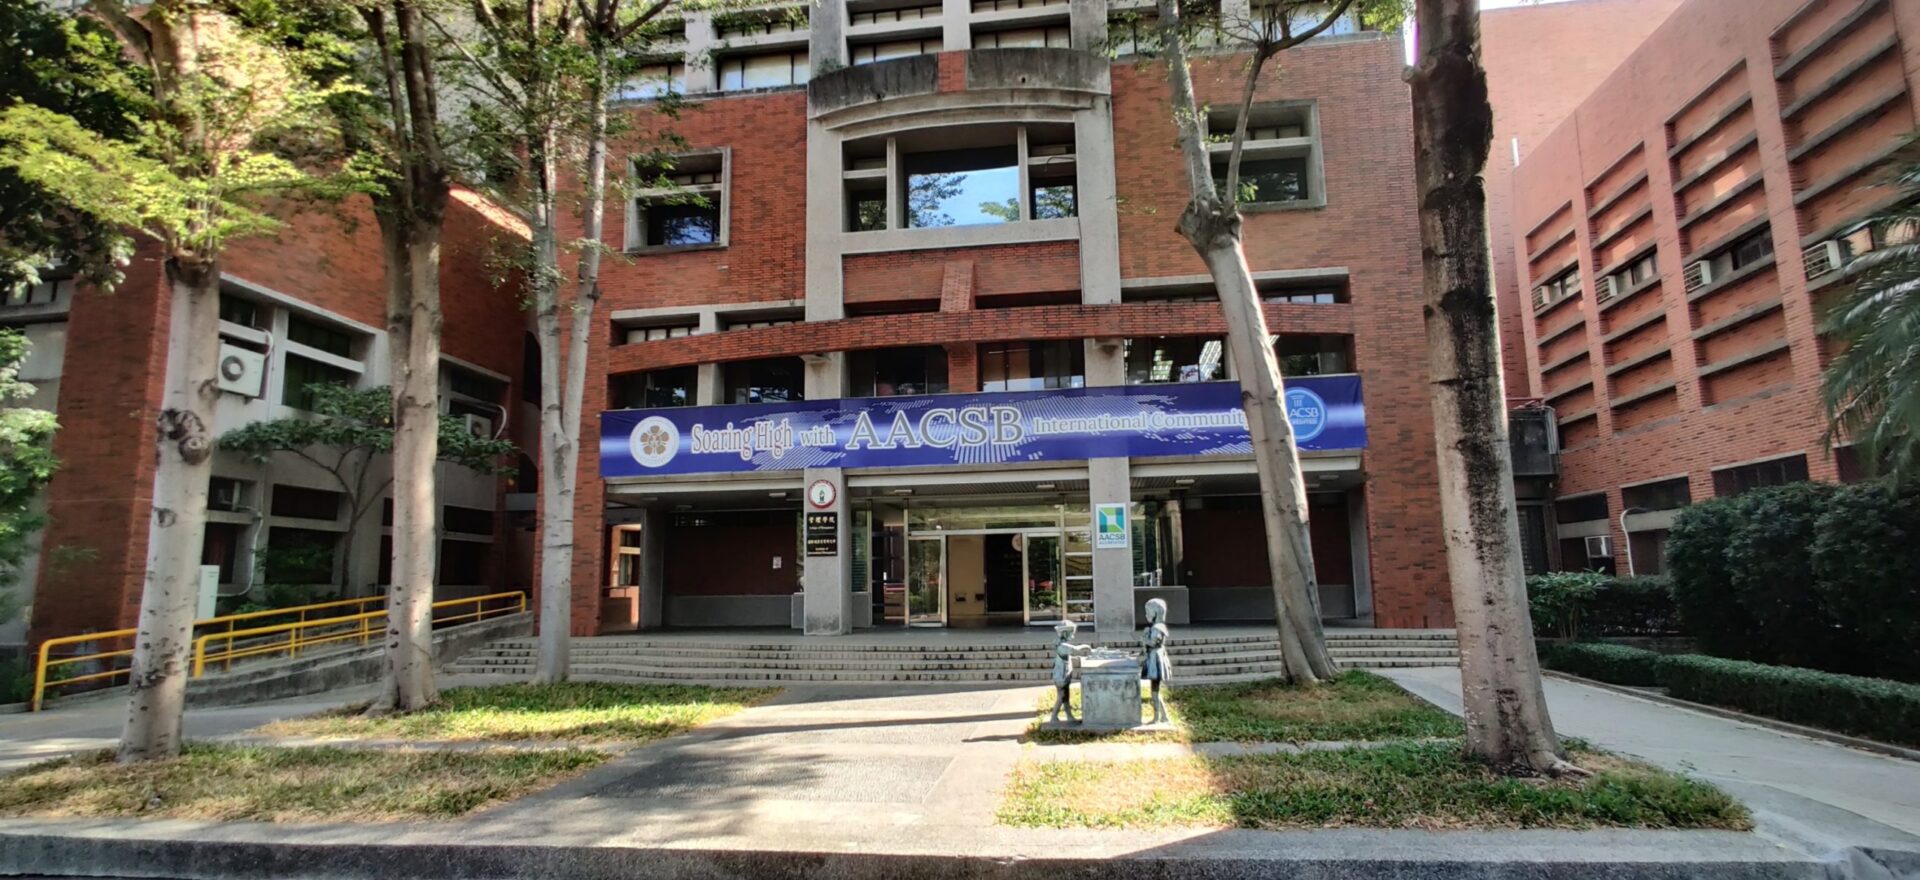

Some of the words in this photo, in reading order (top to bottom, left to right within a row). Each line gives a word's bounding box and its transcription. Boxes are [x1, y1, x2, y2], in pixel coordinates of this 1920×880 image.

[1289, 407, 1319, 418] ACSB
[692, 424, 752, 459] Soaring
[755, 419, 793, 458] High
[800, 424, 836, 446] with
[846, 407, 1024, 449] AACSB
[1034, 412, 1146, 434] International
[1152, 409, 1249, 430] Communit
[1099, 533, 1126, 541] AACSB
